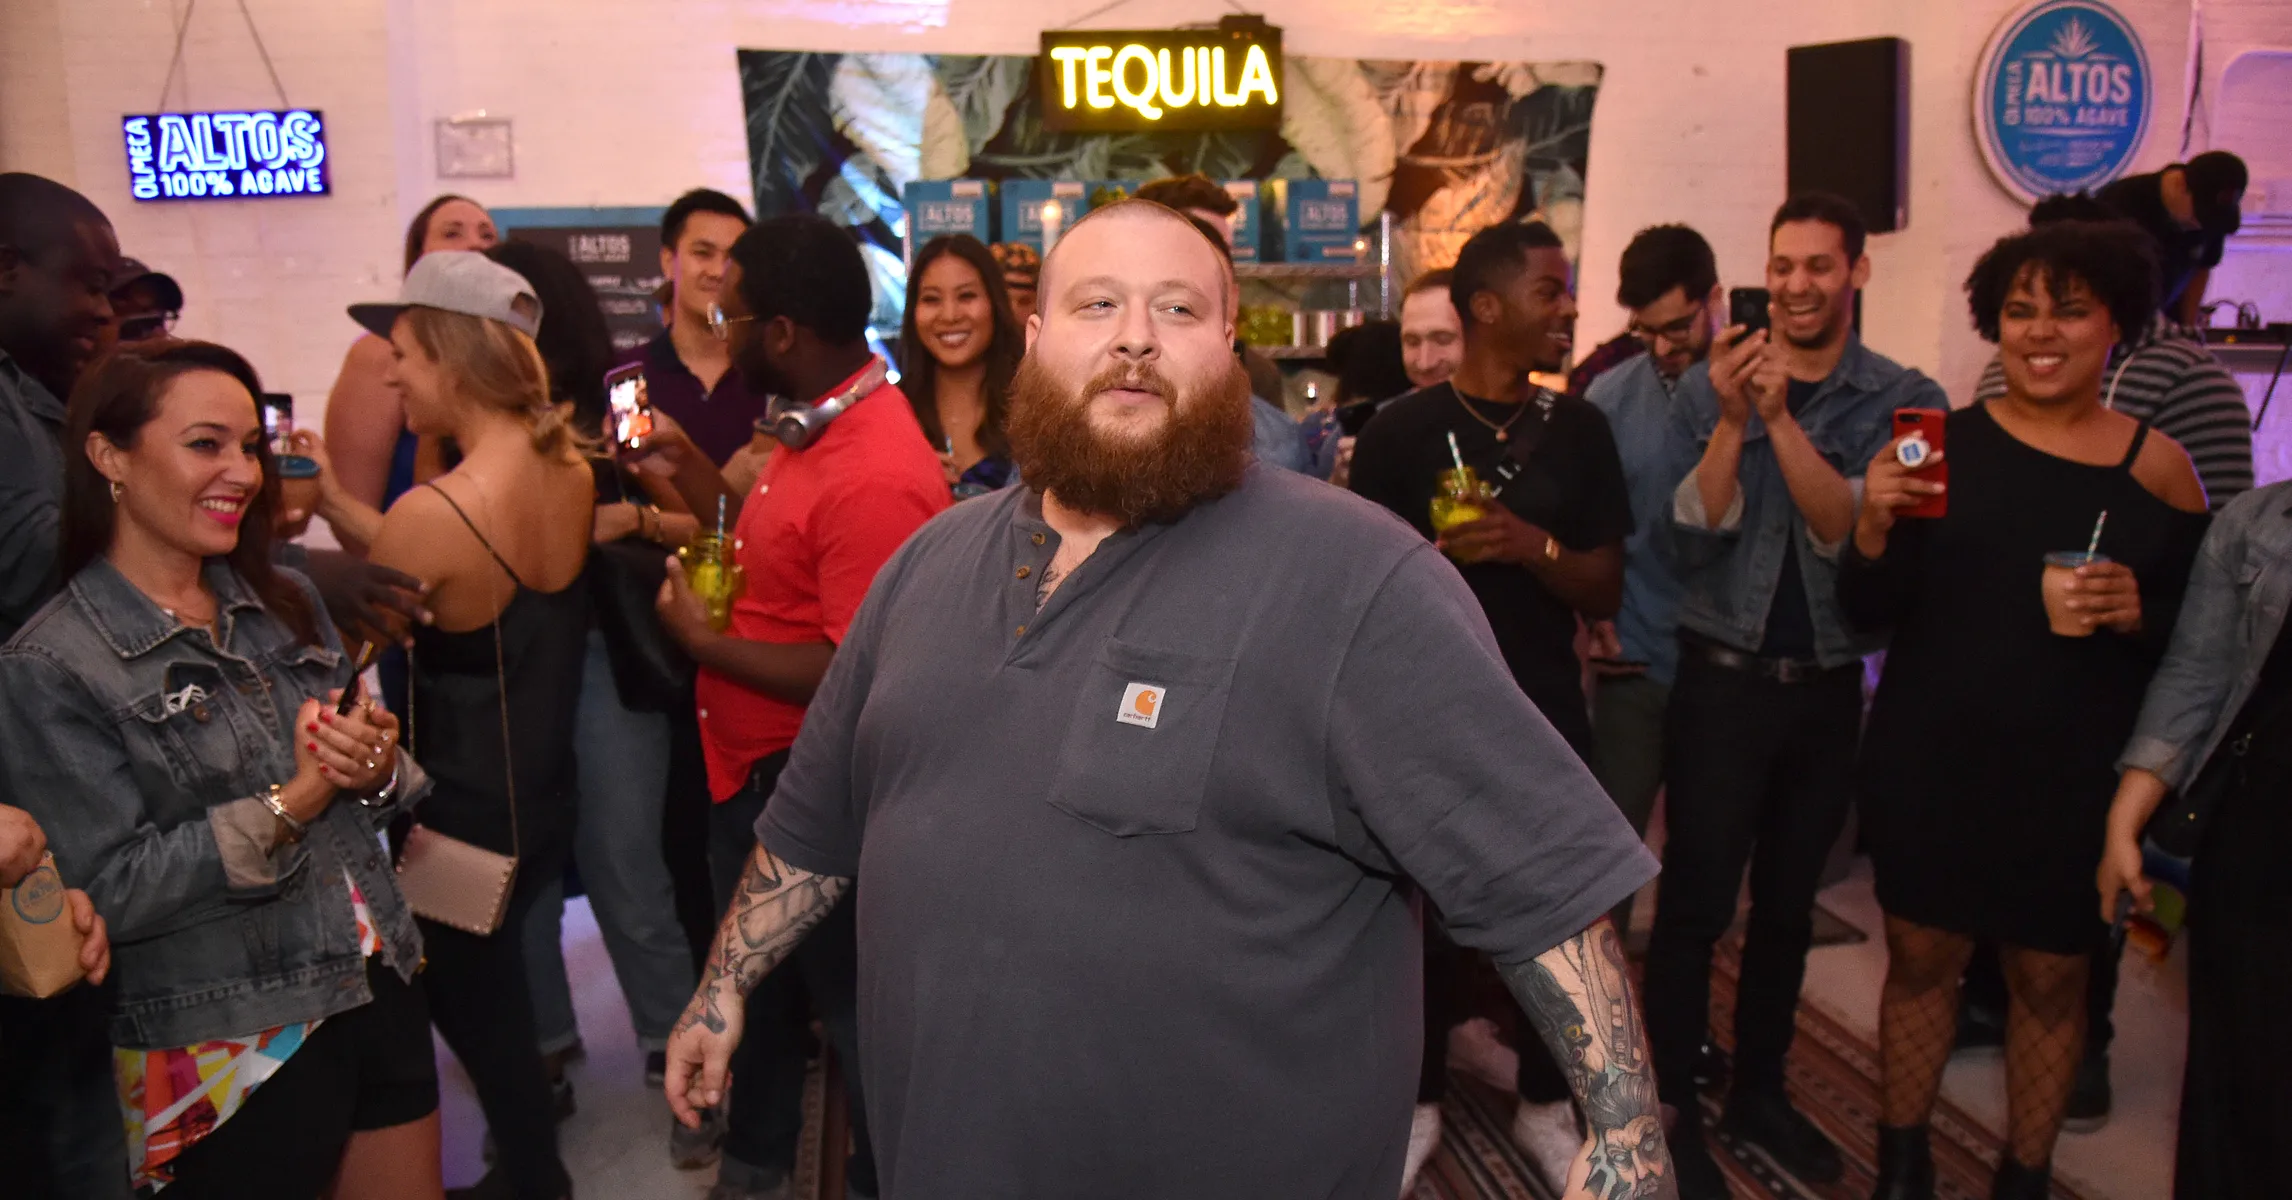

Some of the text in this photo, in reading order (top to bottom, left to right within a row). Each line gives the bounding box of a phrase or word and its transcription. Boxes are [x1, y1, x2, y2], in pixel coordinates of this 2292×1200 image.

[1050, 43, 1278, 120] TEQUILA
[2025, 62, 2133, 105] ALTOS
[2075, 106, 2129, 127] AGAVE
[125, 116, 159, 199] OLMECA
[158, 111, 325, 171] ALTOS
[160, 168, 323, 197] 100% AGAVE
[1123, 712, 1151, 722] carhartt
